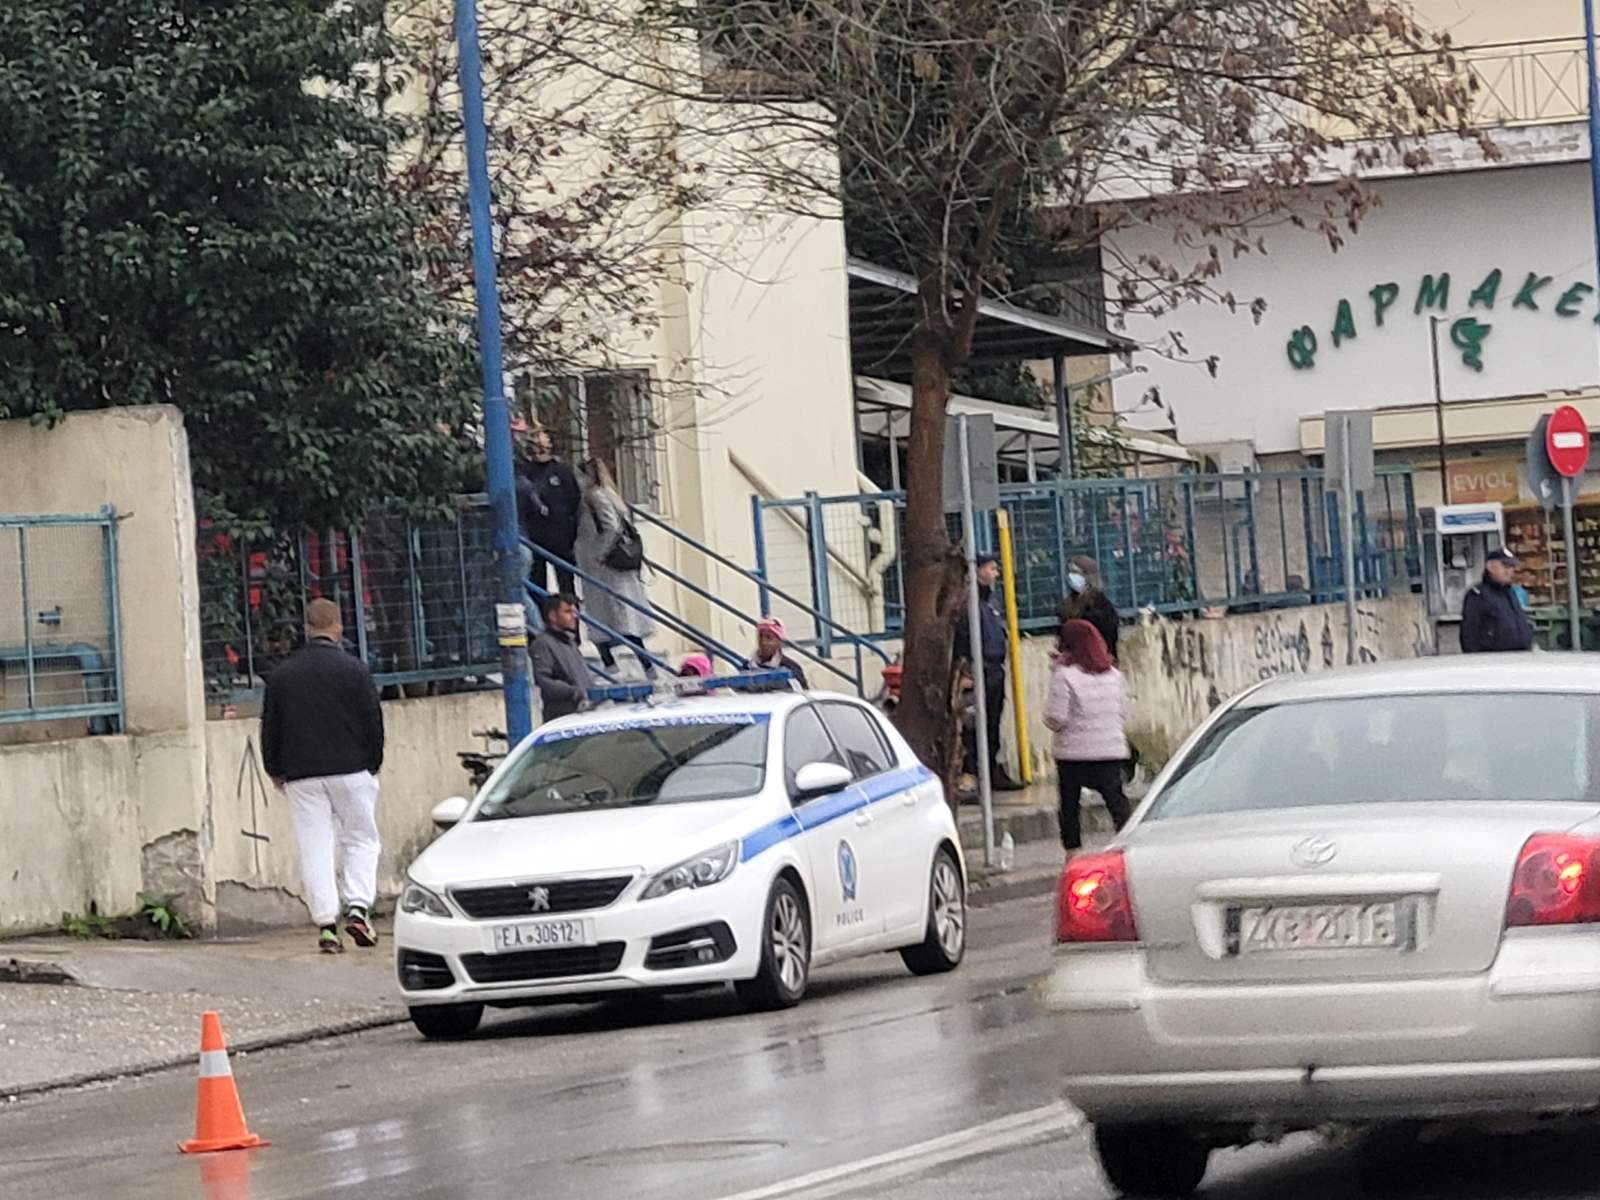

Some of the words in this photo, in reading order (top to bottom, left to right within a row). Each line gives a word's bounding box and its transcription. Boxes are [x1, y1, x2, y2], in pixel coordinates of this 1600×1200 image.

[1287, 267, 1600, 370] ΦΑΡΜΑΚΕ
[1454, 471, 1513, 492] EVIOL
[836, 908, 863, 927] POLICE
[534, 920, 575, 944] 30612
